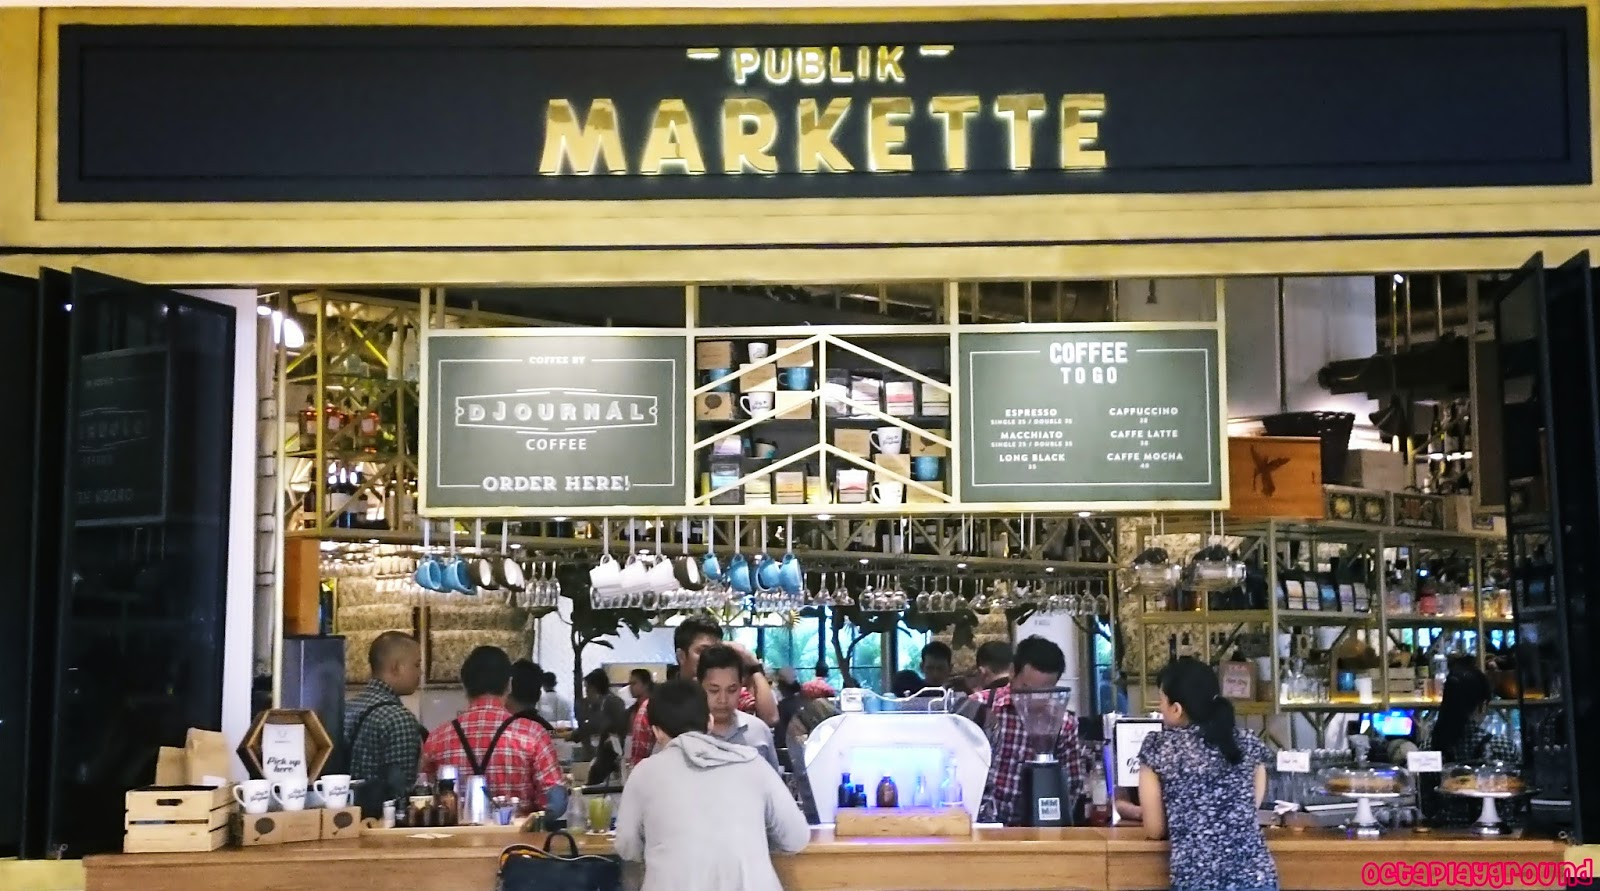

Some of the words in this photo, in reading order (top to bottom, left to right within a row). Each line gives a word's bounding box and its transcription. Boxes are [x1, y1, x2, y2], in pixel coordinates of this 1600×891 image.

[734, 46, 905, 83] PUBLIK
[539, 93, 1107, 175] MARKETTE
[1049, 342, 1128, 364] COFFEE
[1060, 367, 1086, 384] TO
[1092, 367, 1118, 384] GO
[1005, 408, 1057, 417] ESPRESSO
[1109, 407, 1178, 416] CAPPUCCINO
[1000, 431, 1063, 439] MACCHIATO
[1110, 430, 1144, 438] CAFFE
[1147, 429, 1179, 438] LATTE
[526, 438, 587, 450] COFFEE
[999, 454, 1029, 462] LONG
[1032, 453, 1066, 462] BLACK
[1106, 452, 1140, 461] CAFFE
[1143, 452, 1184, 461] MOCHA
[482, 476, 558, 491] ORDER
[565, 475, 631, 491] HERE!
